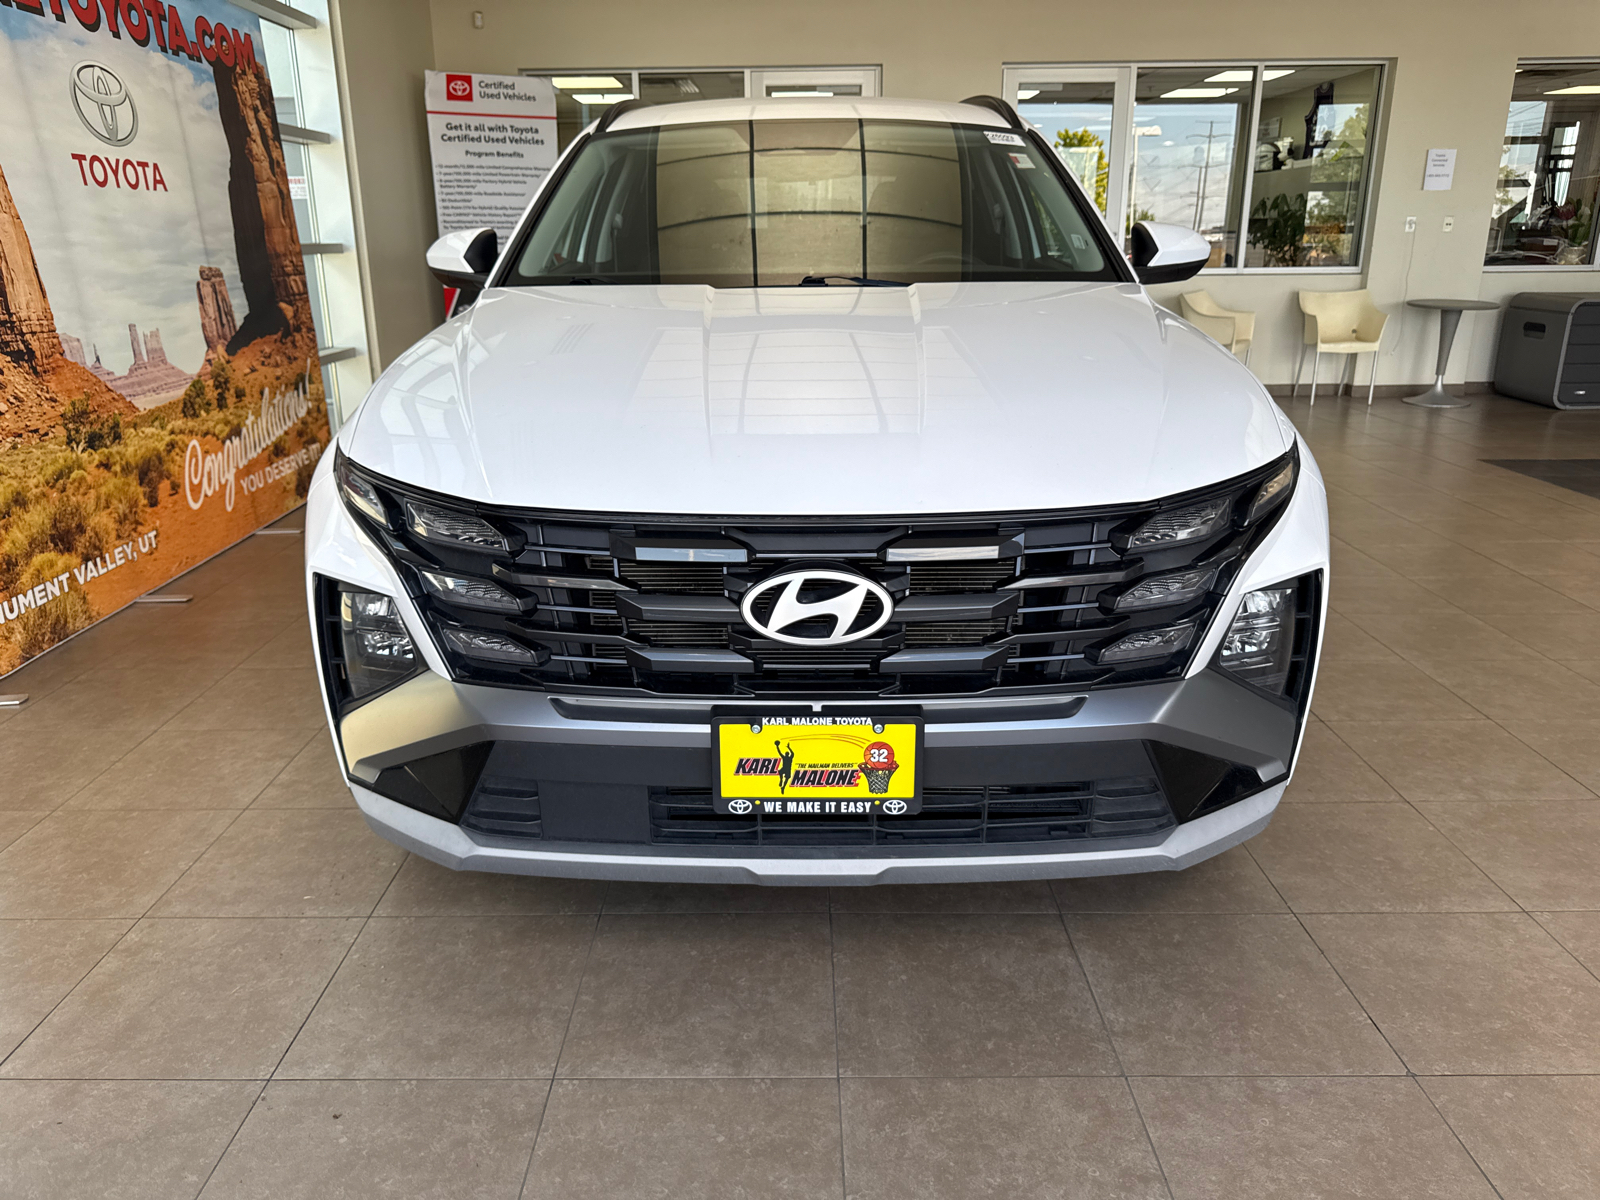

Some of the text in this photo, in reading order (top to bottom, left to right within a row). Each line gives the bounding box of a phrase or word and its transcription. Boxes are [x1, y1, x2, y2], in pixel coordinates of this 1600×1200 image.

[478, 80, 515, 90] Certified
[479, 91, 537, 102] Used Vehicles
[445, 122, 539, 136] Get it all with Toyota
[440, 134, 545, 146] Certified Used Vehicles
[465, 150, 495, 158] Program
[71, 153, 168, 192] TOYOTA
[185, 357, 312, 512] Congratulations!
[240, 470, 265, 495] YOU
[265, 448, 311, 484] DESERVE
[73, 541, 138, 586] VALLEY,
[138, 529, 158, 554] UT
[762, 717, 873, 726] KARL MALONE TOYOTA
[870, 748, 888, 763] 32
[734, 757, 782, 776] KARL
[789, 769, 861, 787] MALONE
[764, 801, 872, 813] WE MAKE IT EASY
